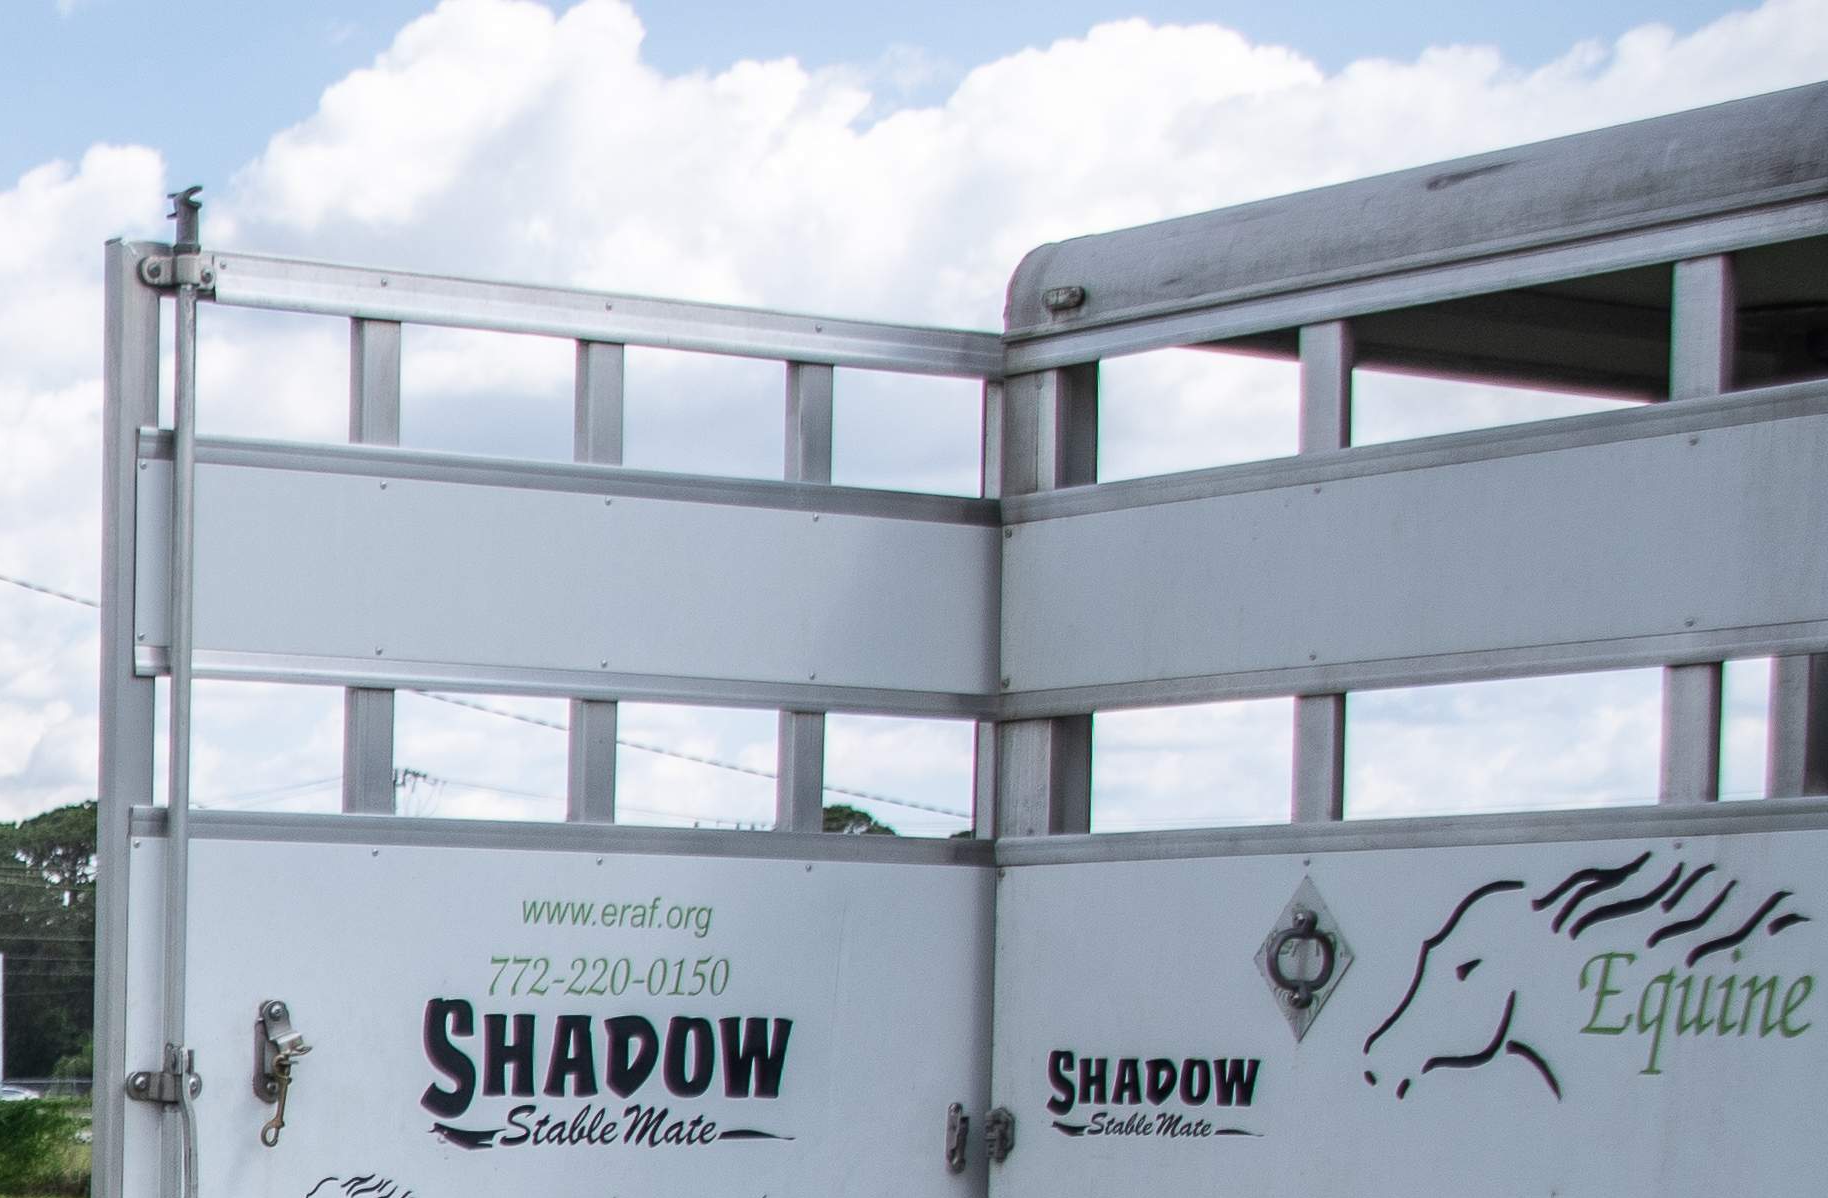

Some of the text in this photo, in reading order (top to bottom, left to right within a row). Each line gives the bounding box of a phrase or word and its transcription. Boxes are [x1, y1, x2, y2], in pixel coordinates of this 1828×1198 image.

[522, 896, 713, 937] www.eraf.org
[488, 956, 730, 997] 772-220-0150
[1579, 949, 1815, 1076] Equine
[420, 997, 794, 1117] SHADOW
[1046, 1049, 1262, 1115] SHADOW
